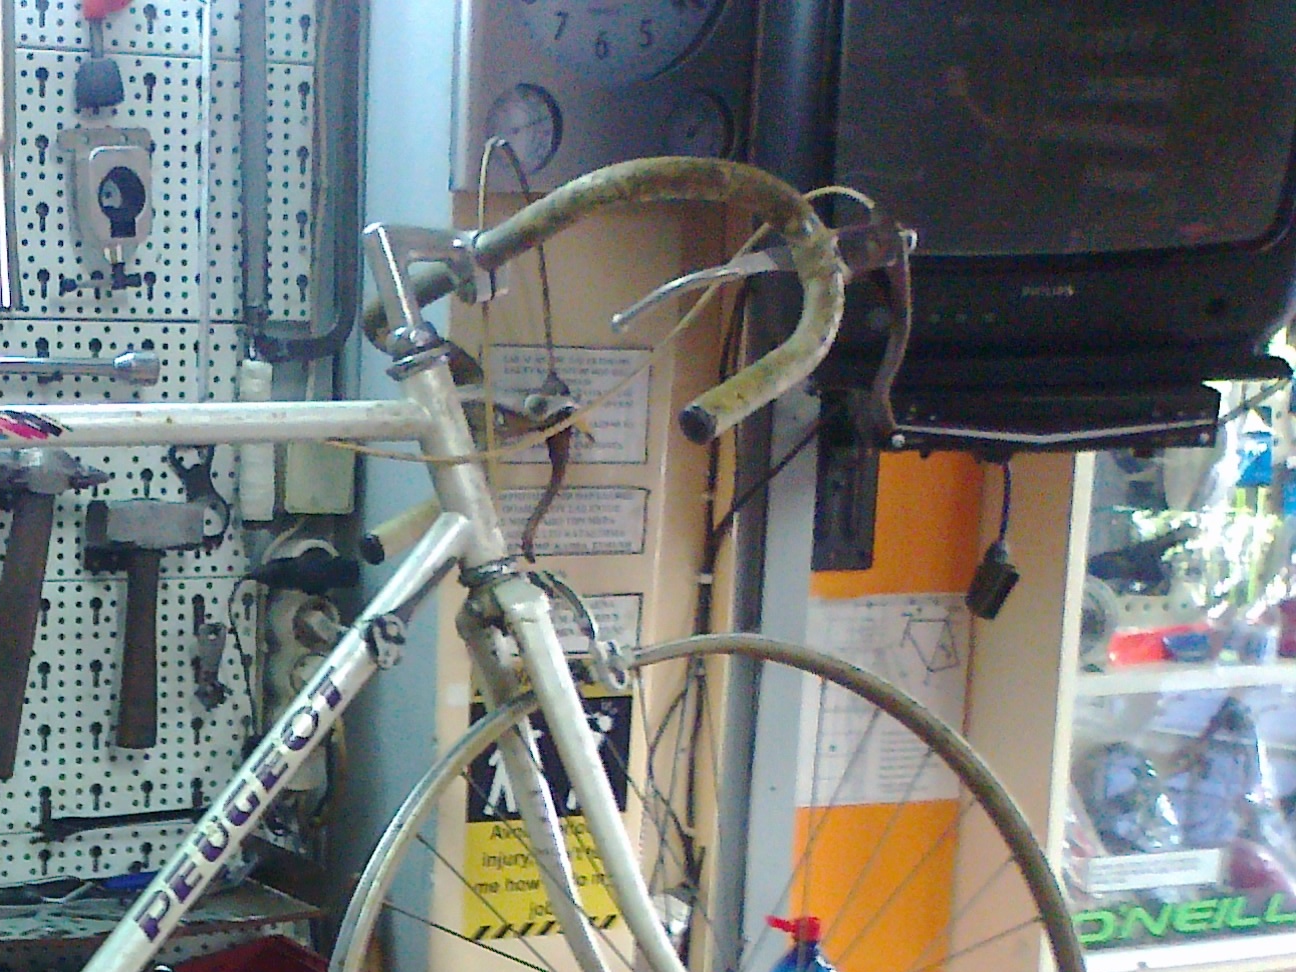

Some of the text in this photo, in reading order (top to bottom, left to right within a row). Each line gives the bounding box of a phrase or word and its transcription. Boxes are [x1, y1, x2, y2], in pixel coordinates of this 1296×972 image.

[554, 10, 569, 41] 7
[639, 18, 653, 48] 5
[594, 30, 610, 60] 6
[133, 664, 343, 942] PEUGEOT
[504, 878, 541, 892] how
